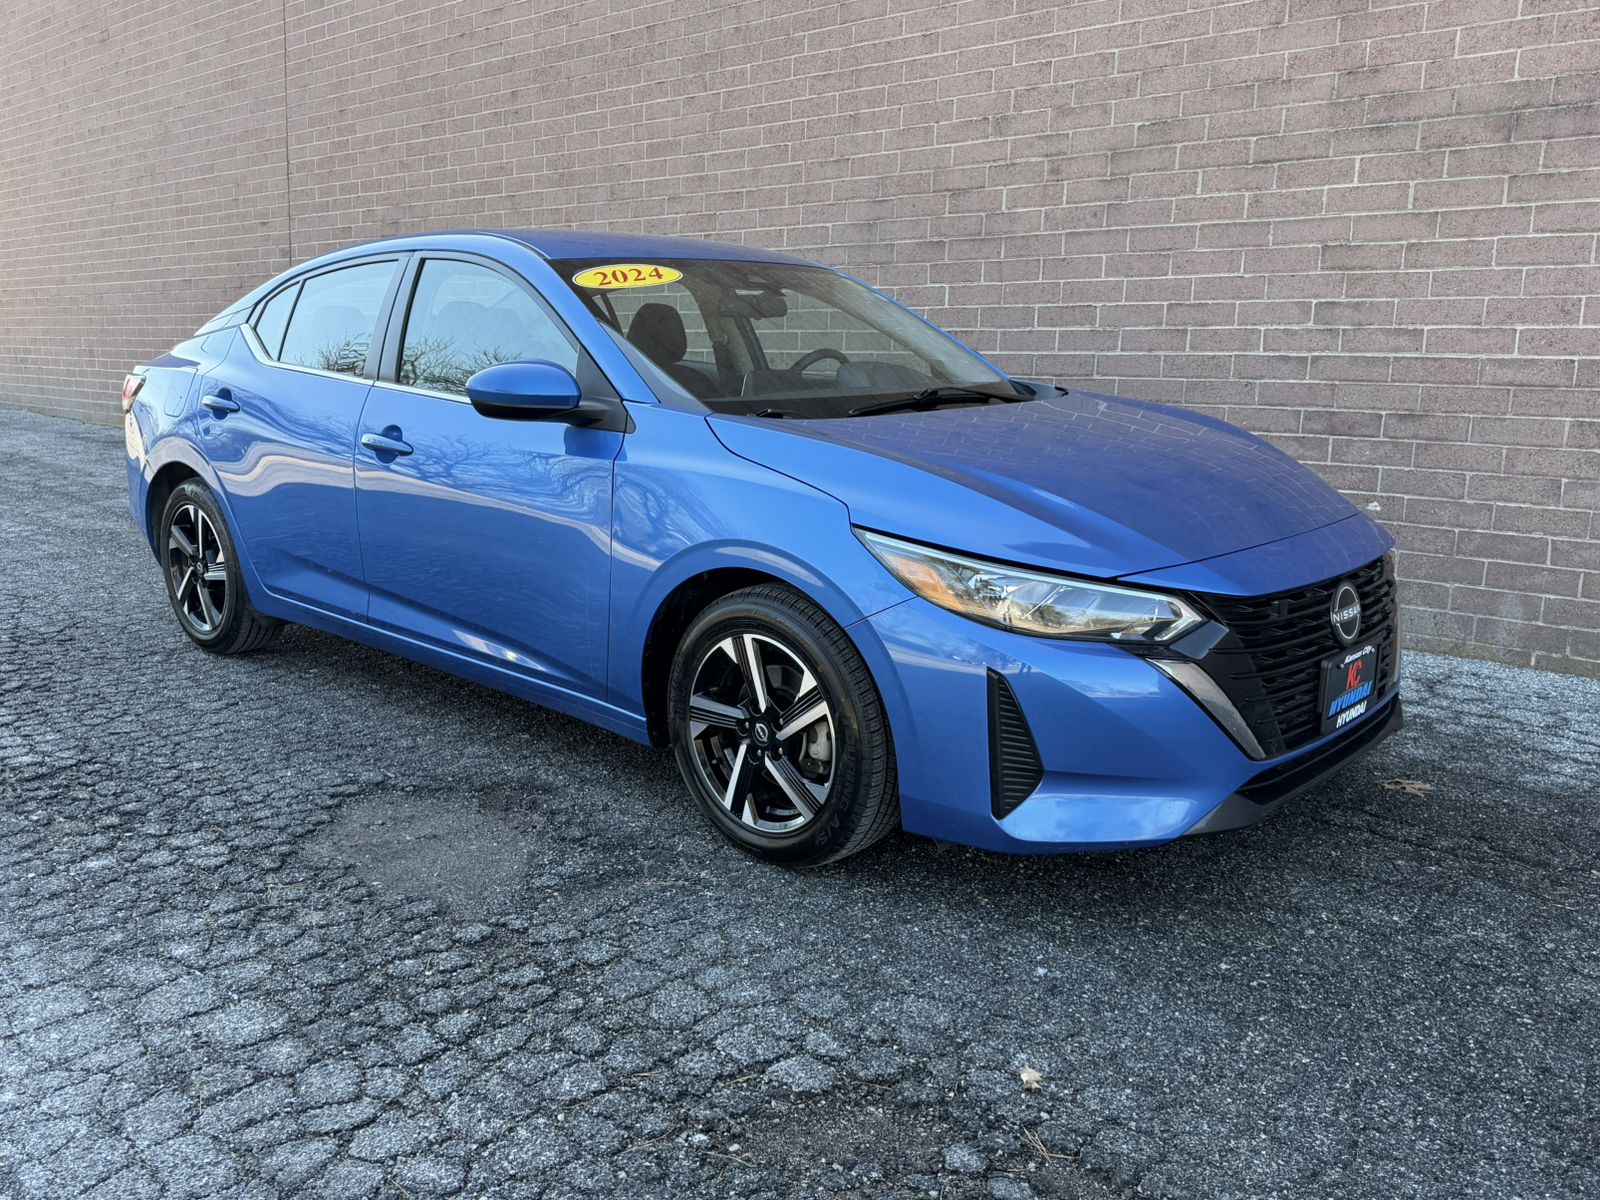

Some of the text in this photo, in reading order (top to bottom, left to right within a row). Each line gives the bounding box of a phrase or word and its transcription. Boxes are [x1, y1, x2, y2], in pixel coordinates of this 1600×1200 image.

[593, 267, 663, 286] 2024
[1332, 604, 1361, 623] NISSAN
[1344, 645, 1373, 664] Kansas City
[1346, 660, 1363, 690] KC
[1328, 681, 1372, 717] HYUNDAI
[1336, 700, 1367, 728] HYUNDAI
[840, 716, 857, 811] TOURING
